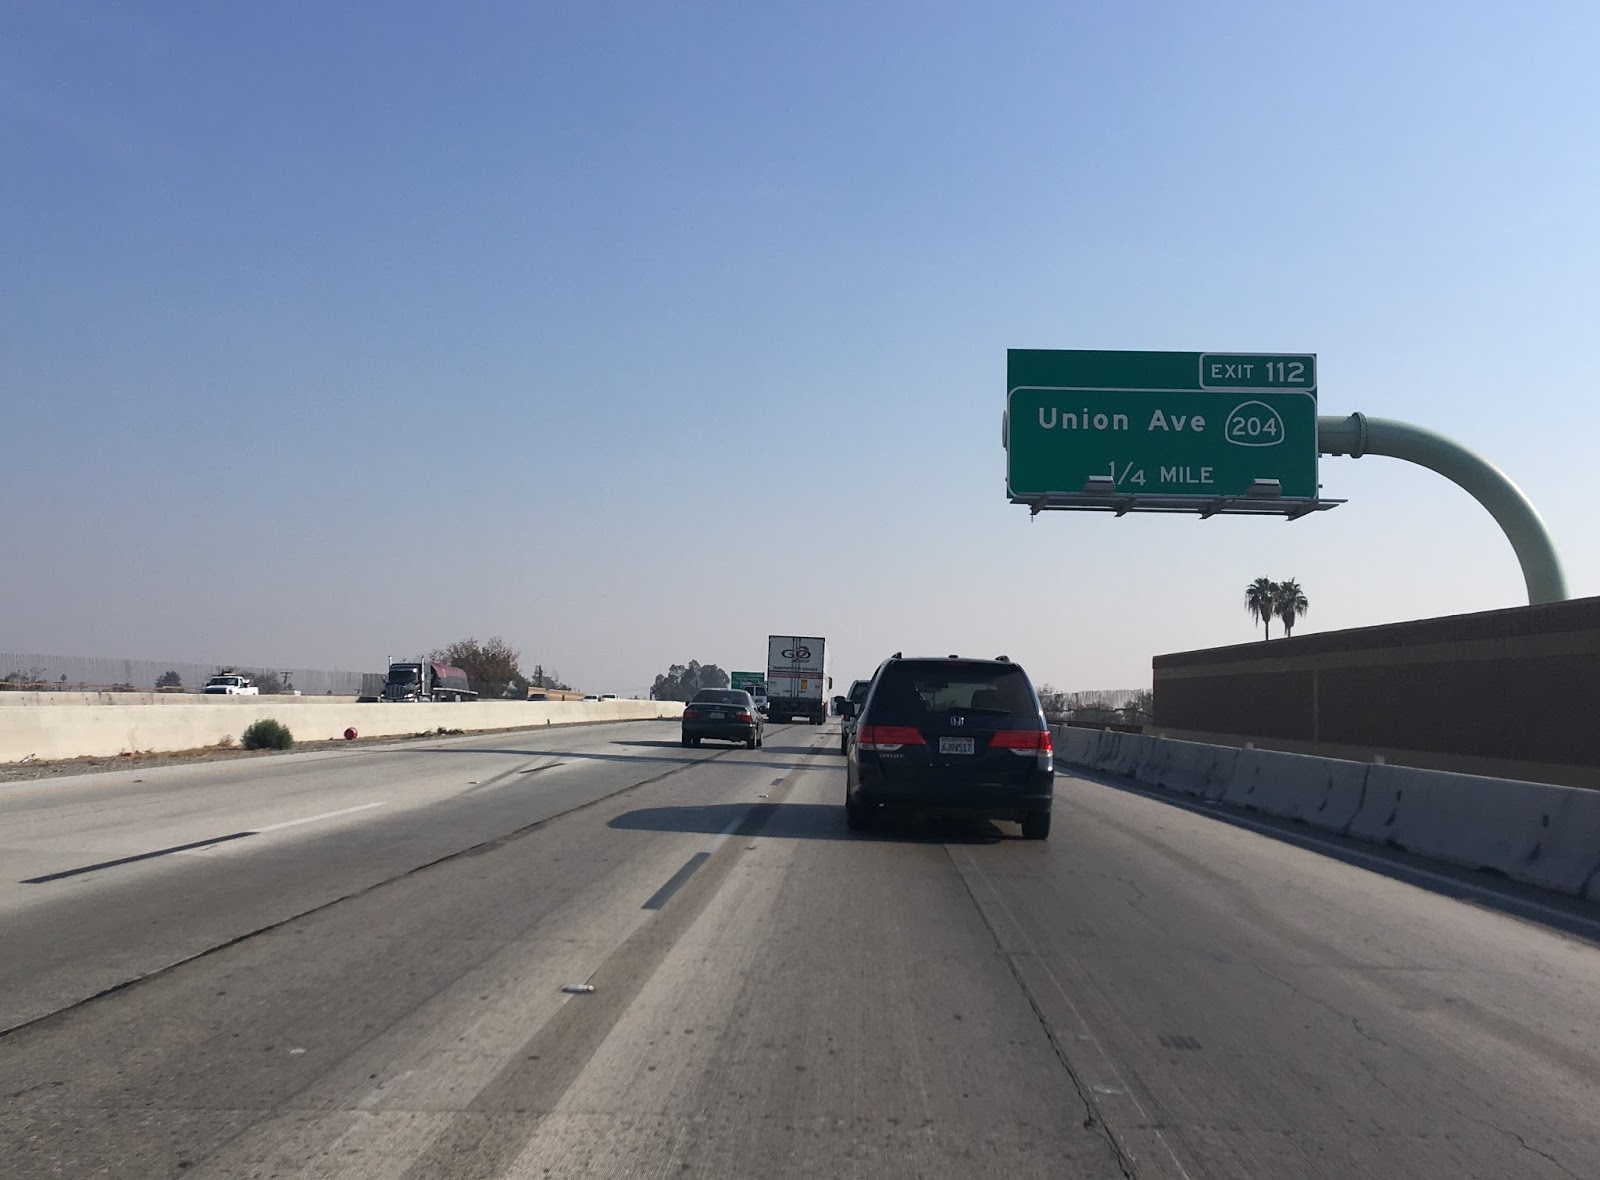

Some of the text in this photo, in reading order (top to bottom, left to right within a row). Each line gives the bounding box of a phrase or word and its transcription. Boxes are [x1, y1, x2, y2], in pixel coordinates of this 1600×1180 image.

[1211, 361, 1305, 383] EXIT 112
[1038, 407, 1277, 436] Union Ave 204
[1108, 461, 1214, 486] 1/4 MILE
